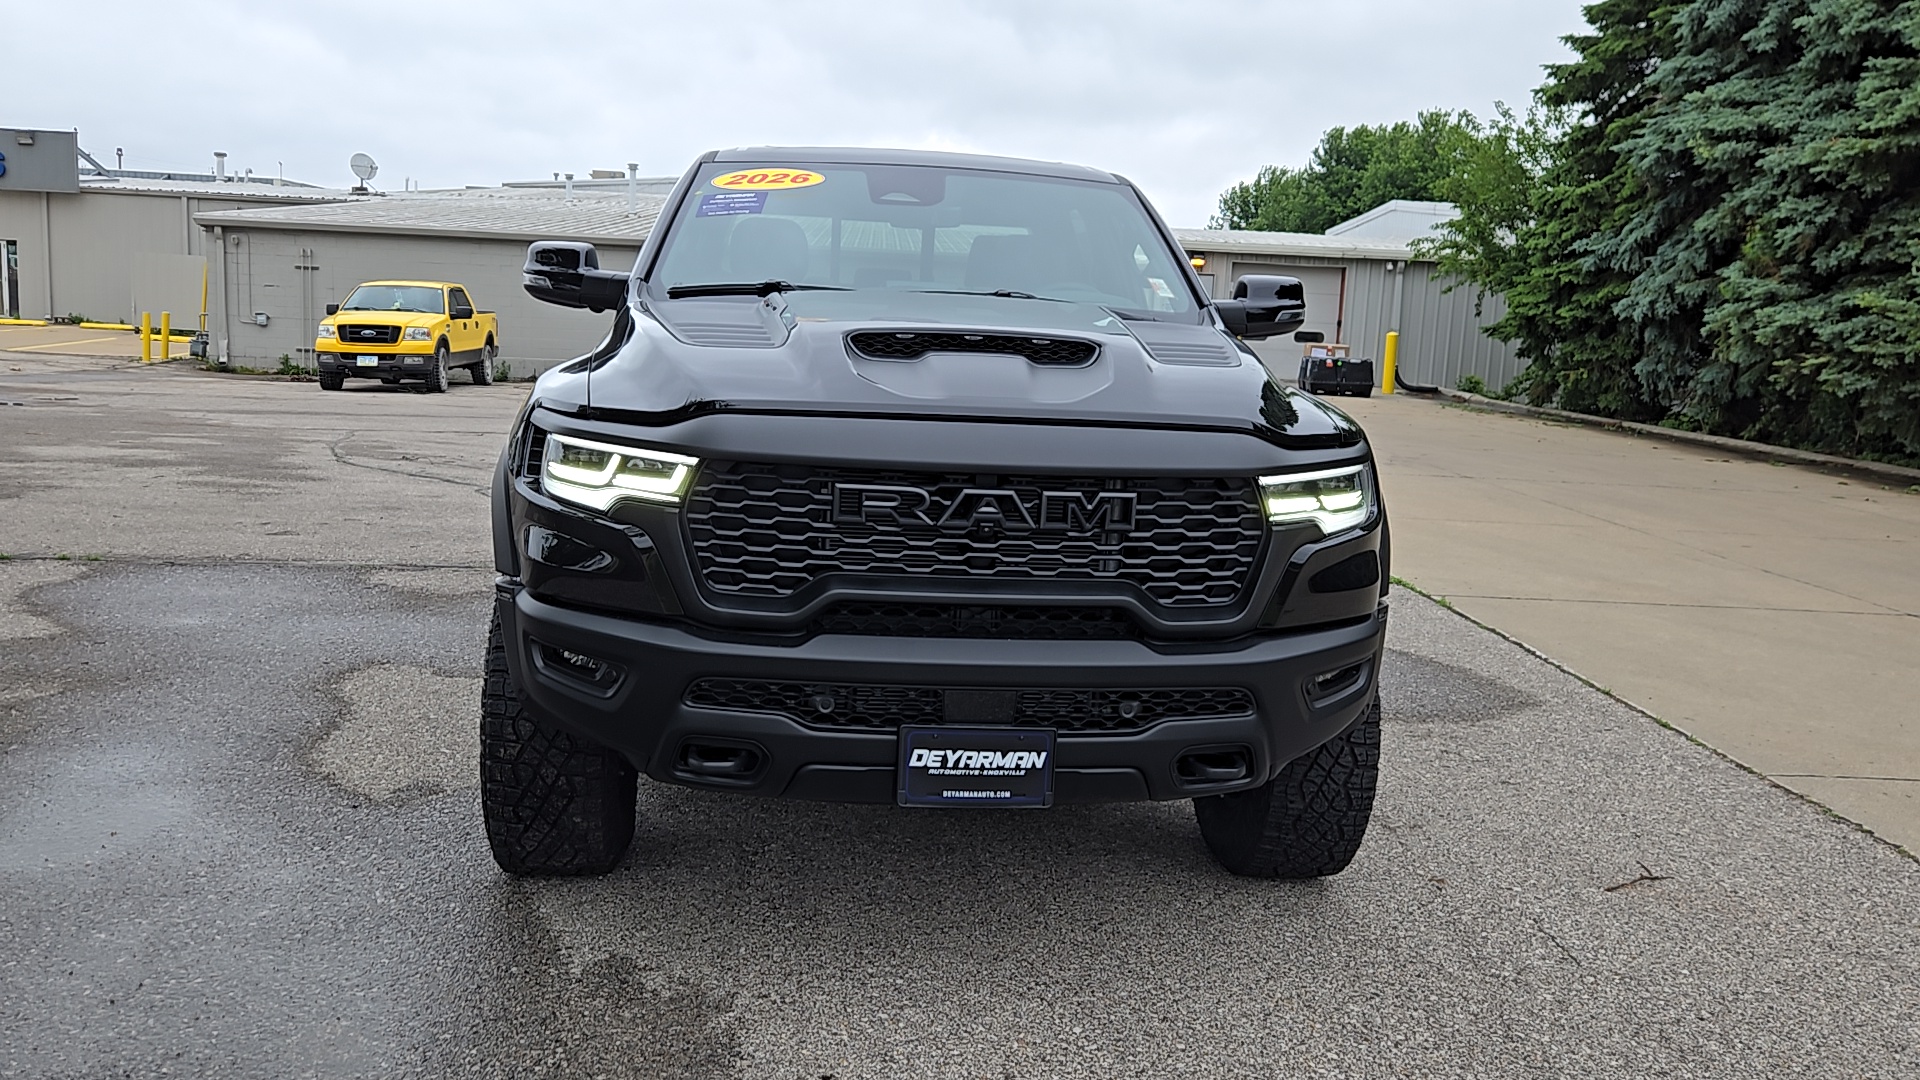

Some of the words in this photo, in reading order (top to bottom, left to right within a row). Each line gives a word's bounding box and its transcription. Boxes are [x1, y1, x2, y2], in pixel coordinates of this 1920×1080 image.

[723, 173, 812, 186] 2026
[833, 482, 1137, 530] RAM
[909, 749, 1047, 768] DEYARMAN
[942, 790, 1011, 798] DEYARMANAUTO.COM
